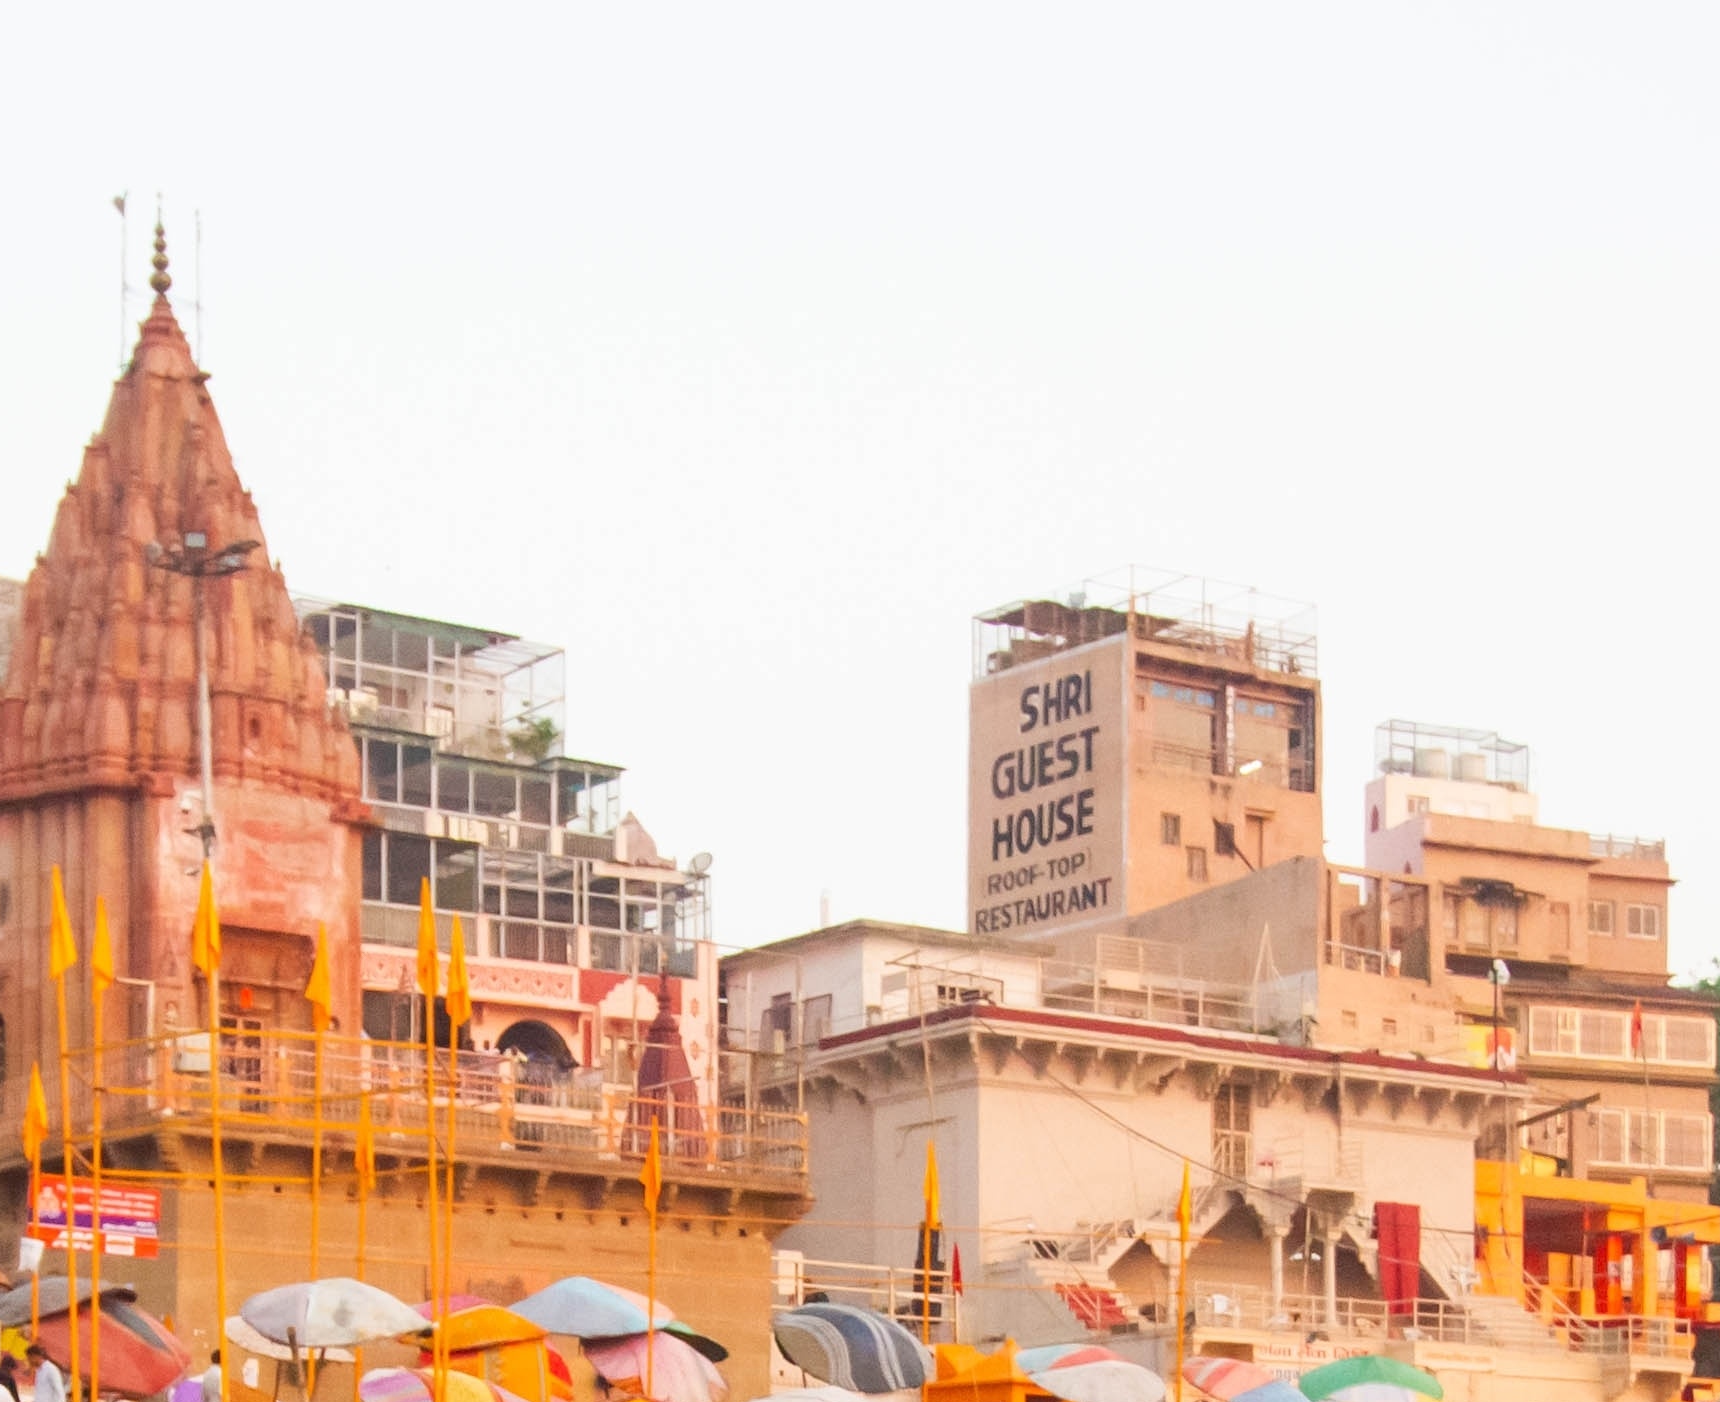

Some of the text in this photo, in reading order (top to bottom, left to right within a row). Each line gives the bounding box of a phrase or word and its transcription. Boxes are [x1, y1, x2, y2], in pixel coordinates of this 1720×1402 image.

[1020, 670, 1092, 733] SHRI
[992, 726, 1099, 799] GUEST
[992, 788, 1094, 861] HOUSE
[975, 877, 1112, 934] RESTAURANT
